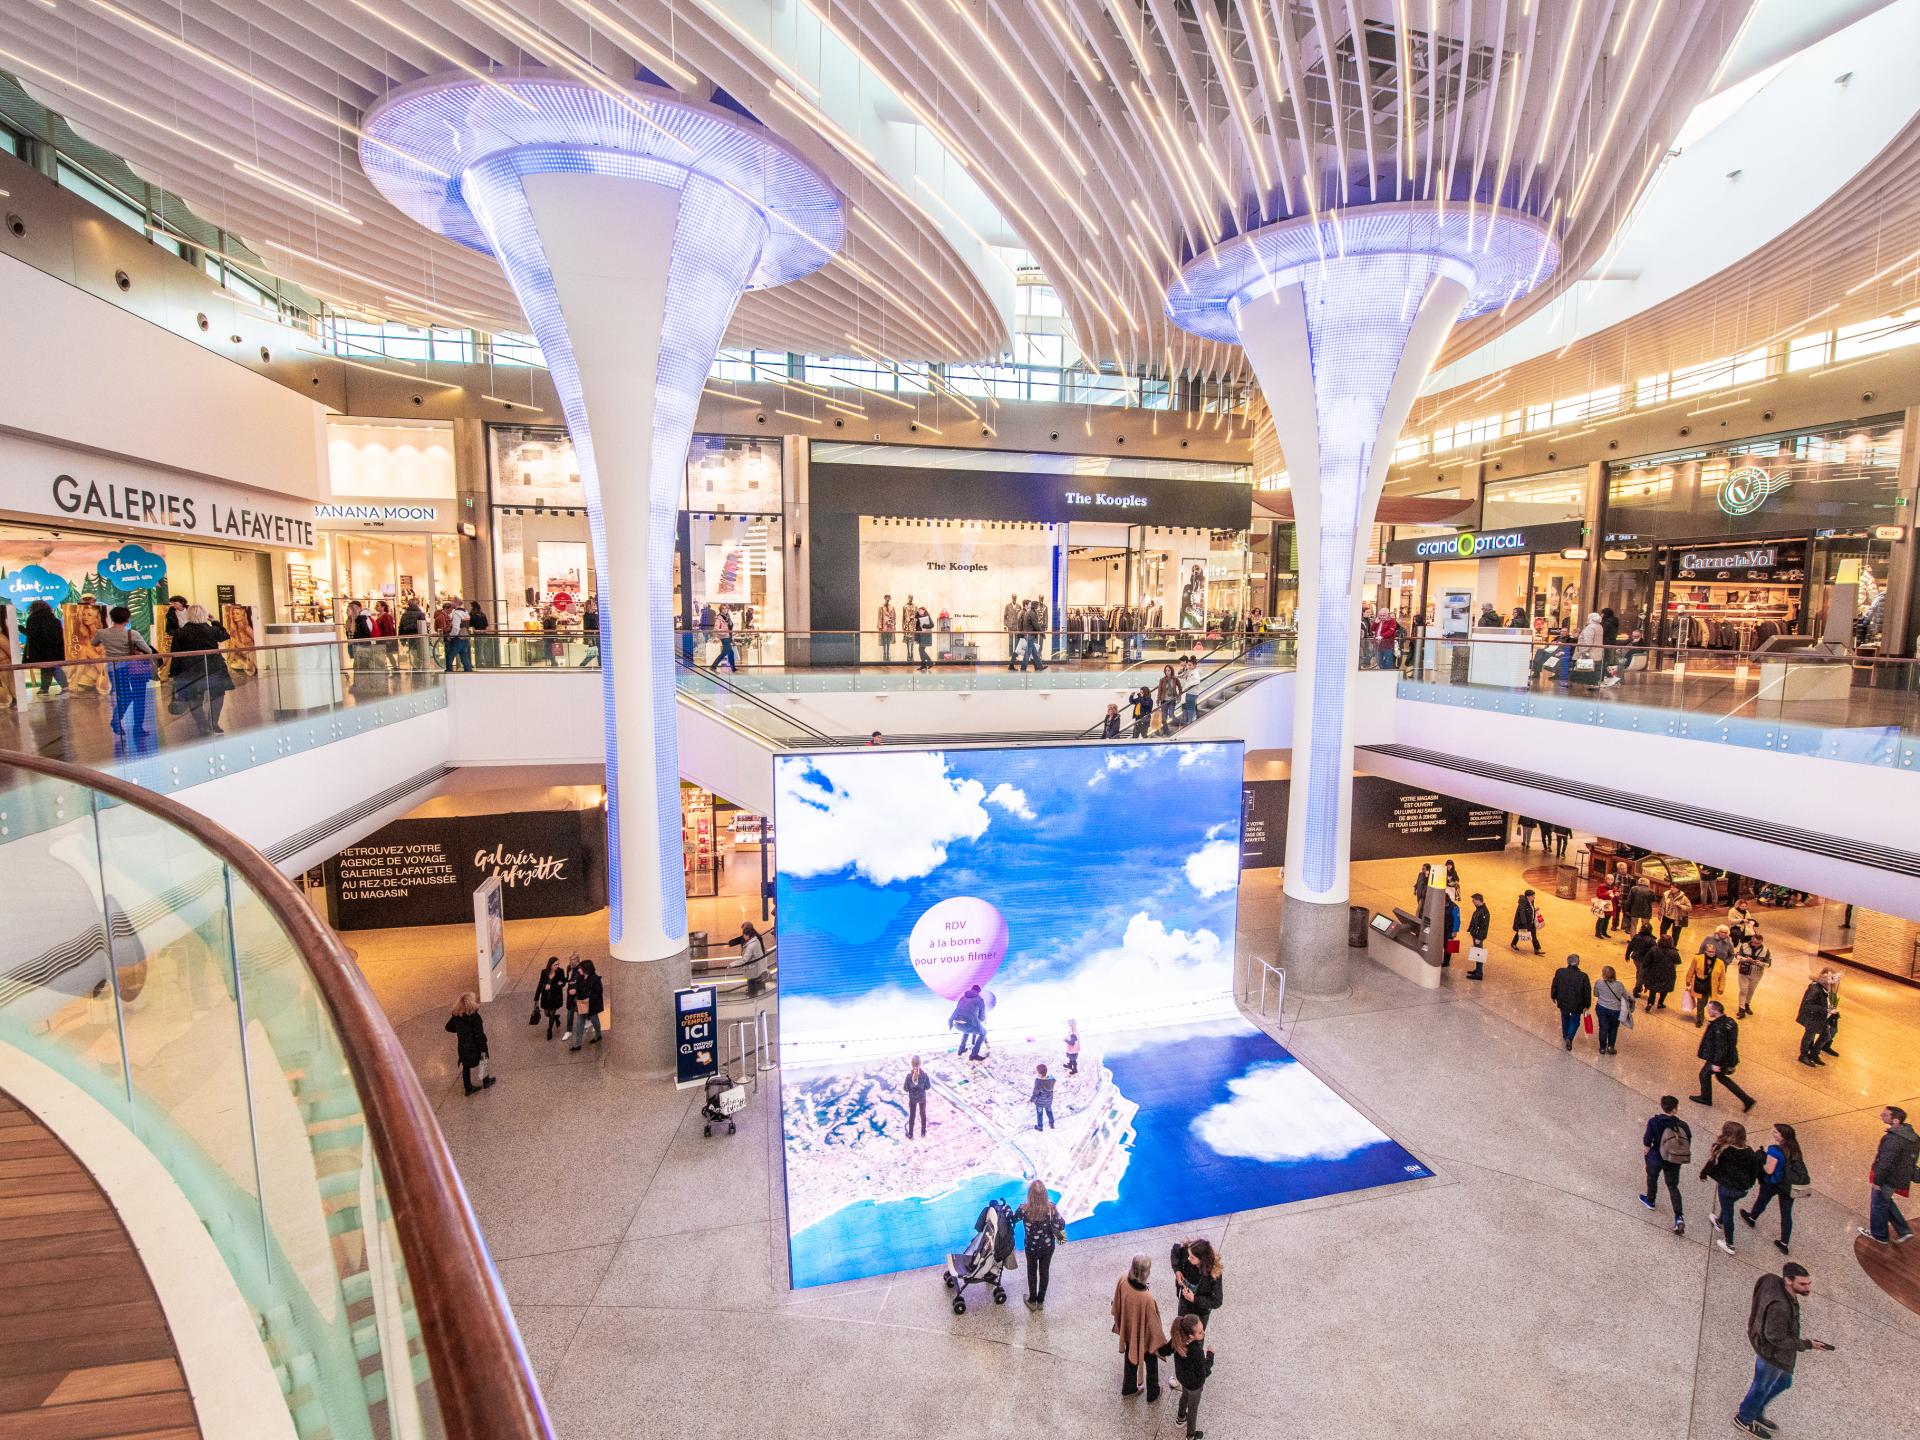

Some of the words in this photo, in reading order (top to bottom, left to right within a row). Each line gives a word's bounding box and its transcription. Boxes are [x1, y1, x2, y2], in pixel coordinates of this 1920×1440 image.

[1065, 492, 1092, 504] The
[1095, 493, 1148, 508] Kooples
[53, 474, 197, 530] GALERIES
[212, 503, 313, 546] LAFAYETTE
[384, 507, 434, 520] MOON
[1745, 549, 1777, 567] Vol
[926, 562, 946, 570] The
[949, 562, 988, 573] Kooples
[340, 846, 404, 857] RETROUVEZ
[406, 844, 442, 854] VOTRE
[340, 857, 384, 868] AGENCE
[387, 856, 402, 866] DE
[404, 855, 446, 865] VOYAGE
[341, 868, 393, 879] GALERIES
[395, 864, 453, 876] LAFAYETTE
[342, 881, 357, 889] AU
[359, 874, 457, 888] REZ-DE-CHAUSSÉE
[342, 891, 358, 900] DU
[360, 889, 408, 899] MAGASIN
[945, 921, 967, 931] RDV
[929, 939, 935, 948] à
[937, 938, 947, 948] la
[950, 937, 981, 947] borne
[914, 957, 937, 967] pour
[940, 954, 965, 964] vous
[681, 1016, 711, 1027] D'EMPLOI
[684, 1012, 709, 1021] OFFRES
[685, 1023, 709, 1040] ICI
